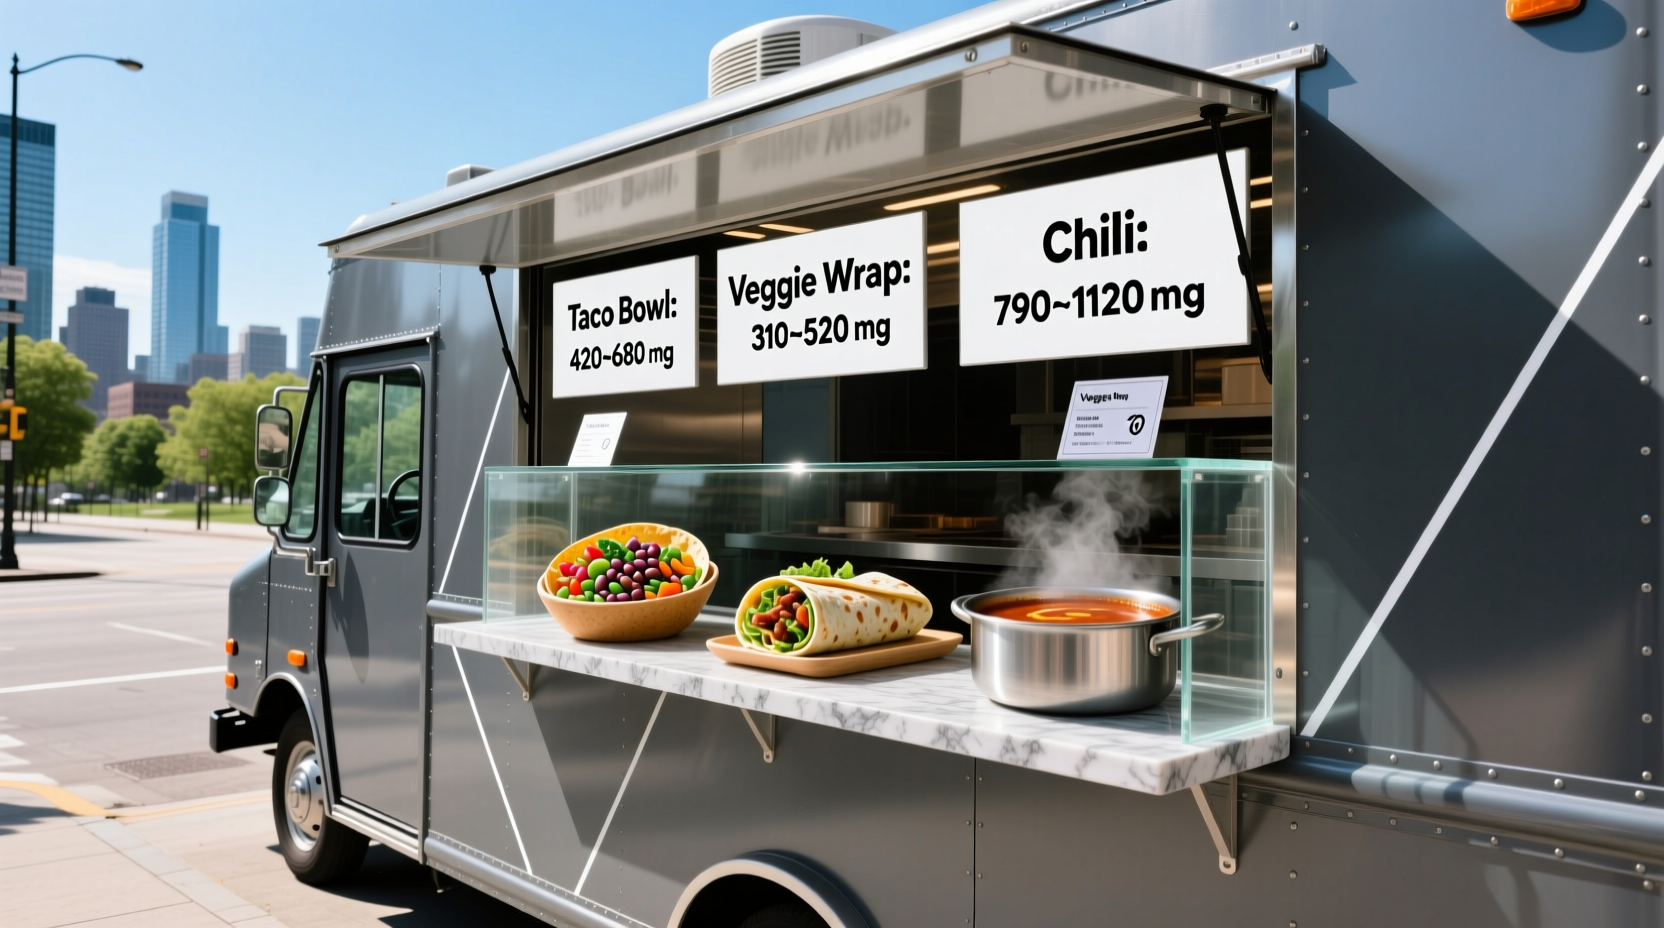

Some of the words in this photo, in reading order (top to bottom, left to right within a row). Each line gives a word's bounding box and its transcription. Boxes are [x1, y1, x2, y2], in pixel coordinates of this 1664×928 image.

[1043, 208, 1148, 264] Chili:
[728, 265, 817, 311] Veggie
[823, 257, 911, 297] Wrap:
[993, 279, 1145, 326] 790~1120
[1150, 282, 1205, 319] mg
[568, 302, 615, 332] Taco
[618, 288, 678, 325] Bowl:
[751, 313, 849, 352] 310~520
[854, 317, 891, 347] mg
[648, 345, 674, 370] mg
